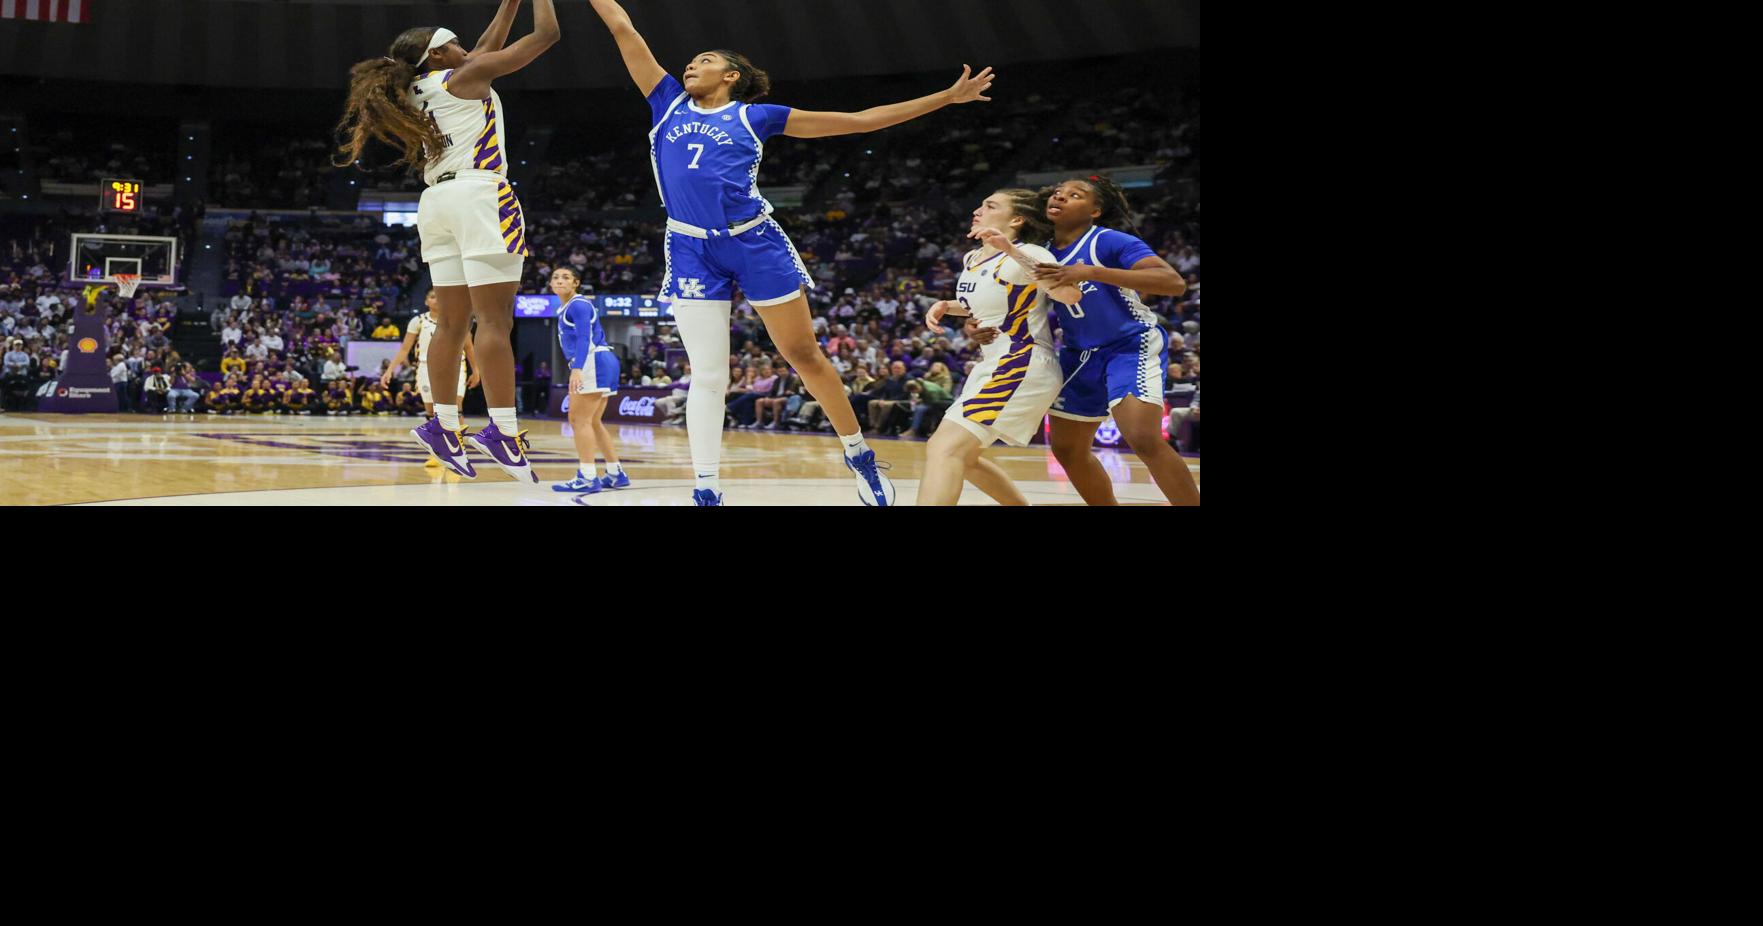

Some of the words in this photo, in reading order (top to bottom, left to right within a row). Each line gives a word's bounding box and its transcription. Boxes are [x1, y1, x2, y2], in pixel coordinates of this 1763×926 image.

[665, 121, 733, 146] KENTUCKY
[687, 143, 704, 169] 7
[112, 182, 139, 193] 9:31
[115, 193, 135, 209] 15
[677, 277, 706, 299] UK
[956, 282, 976, 293] SU
[605, 297, 632, 307] 9:32
